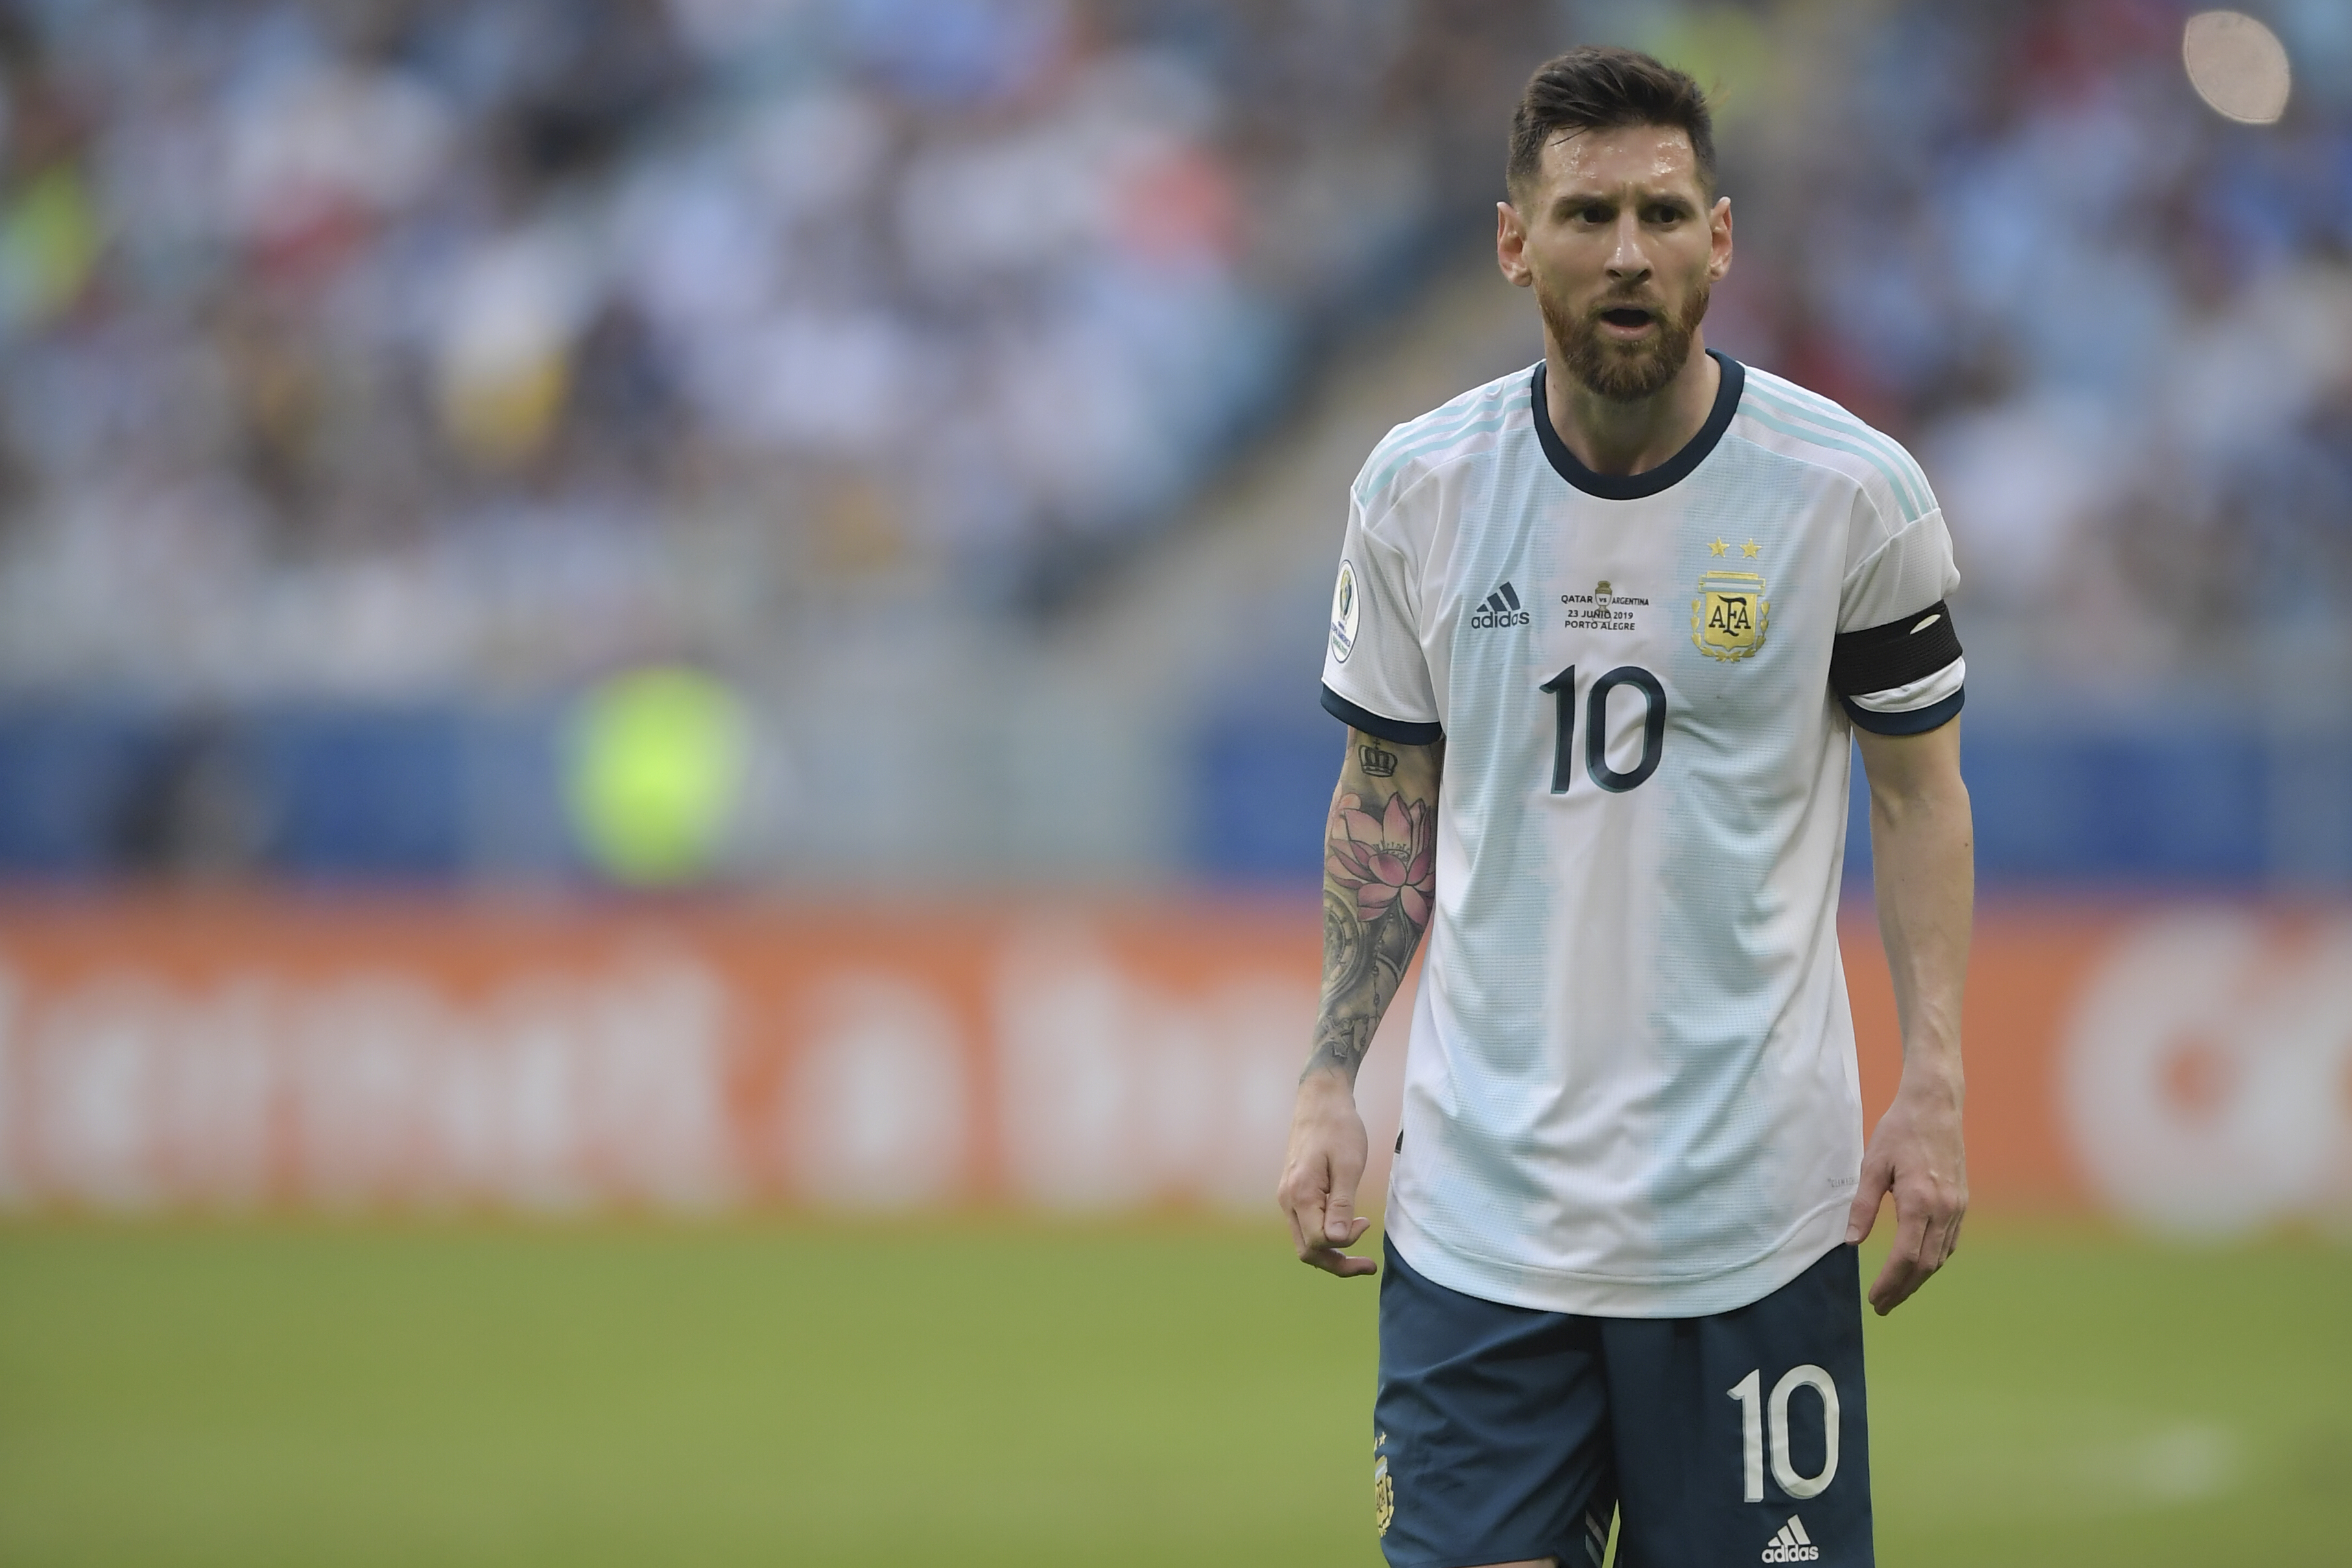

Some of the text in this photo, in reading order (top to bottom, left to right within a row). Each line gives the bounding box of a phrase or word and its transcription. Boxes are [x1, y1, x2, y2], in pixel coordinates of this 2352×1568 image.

[1561, 595, 1593, 604] QATAR
[1611, 597, 1650, 606] ARGENTINA
[1471, 611, 1530, 629] adidas
[1568, 610, 1578, 618] 23
[1581, 610, 1611, 619] JUNIO
[1708, 594, 1752, 637] AFA
[1565, 621, 1635, 630] PORTO ALEGRE
[1539, 664, 1666, 794] 10
[1726, 1364, 1840, 1503] 10
[1761, 1544, 1819, 1563] adidas
